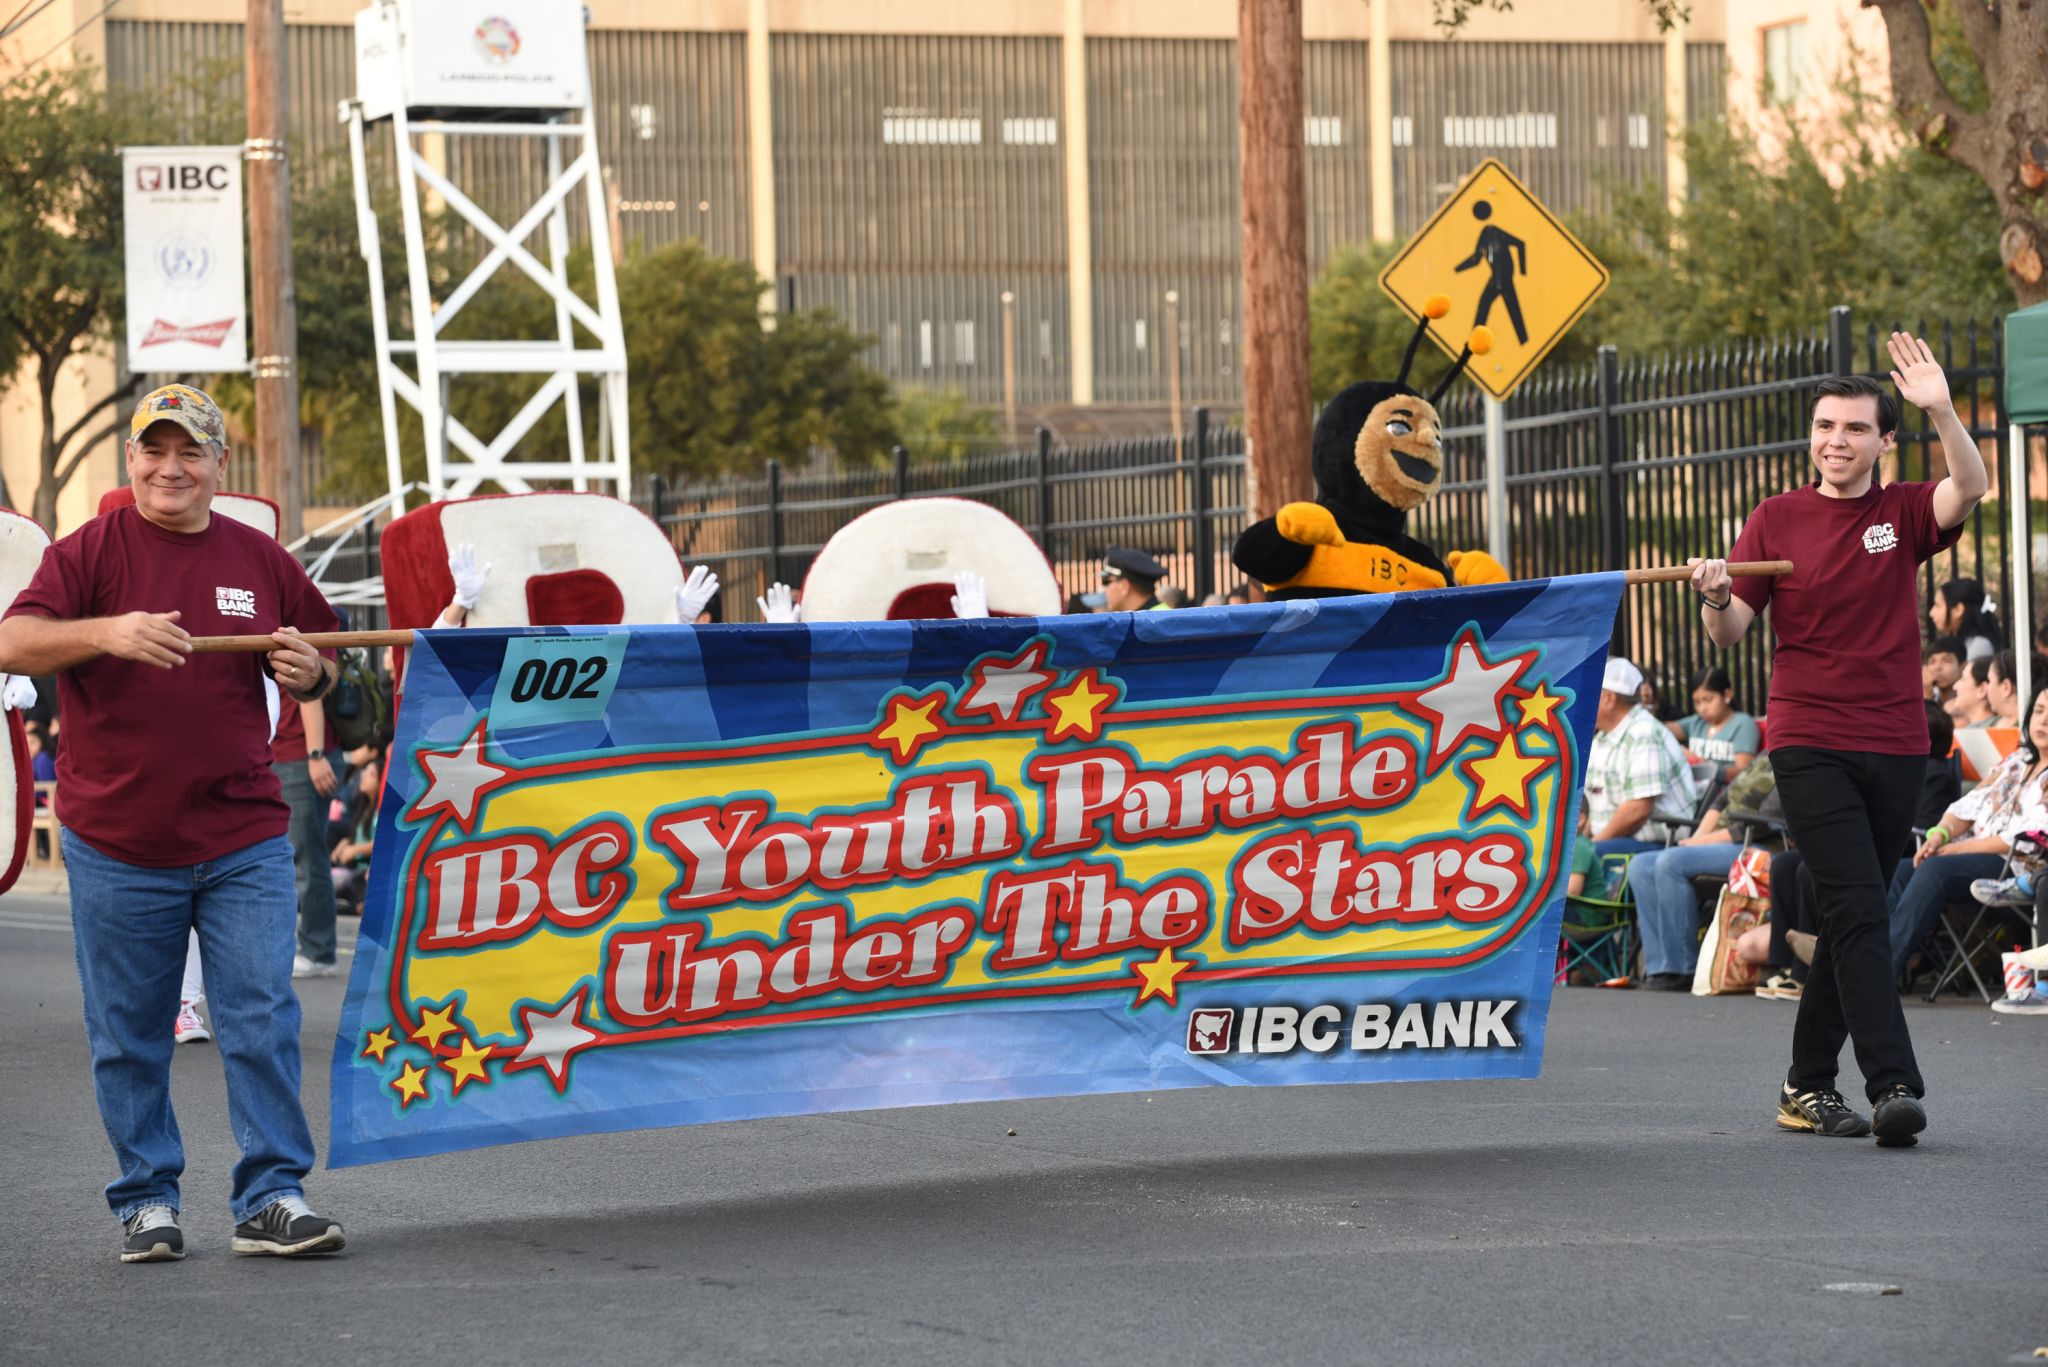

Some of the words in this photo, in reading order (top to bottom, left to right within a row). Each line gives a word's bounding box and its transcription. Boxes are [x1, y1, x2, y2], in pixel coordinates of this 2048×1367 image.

[168, 165, 229, 191] IBC
[1863, 532, 1899, 549] BANK
[1871, 522, 1894, 536] IBC
[1371, 557, 1408, 586] IBC
[217, 599, 258, 614] BANK
[229, 587, 255, 603] IBC
[510, 655, 608, 703] 002
[428, 832, 619, 941] IBC
[660, 779, 1012, 901] Youth
[1038, 730, 1407, 850] Parade
[614, 915, 966, 1017] Under
[993, 869, 1199, 963] The
[1238, 838, 1518, 936] Stars
[1239, 1005, 1342, 1054] IBC
[1350, 999, 1520, 1051] BANK
